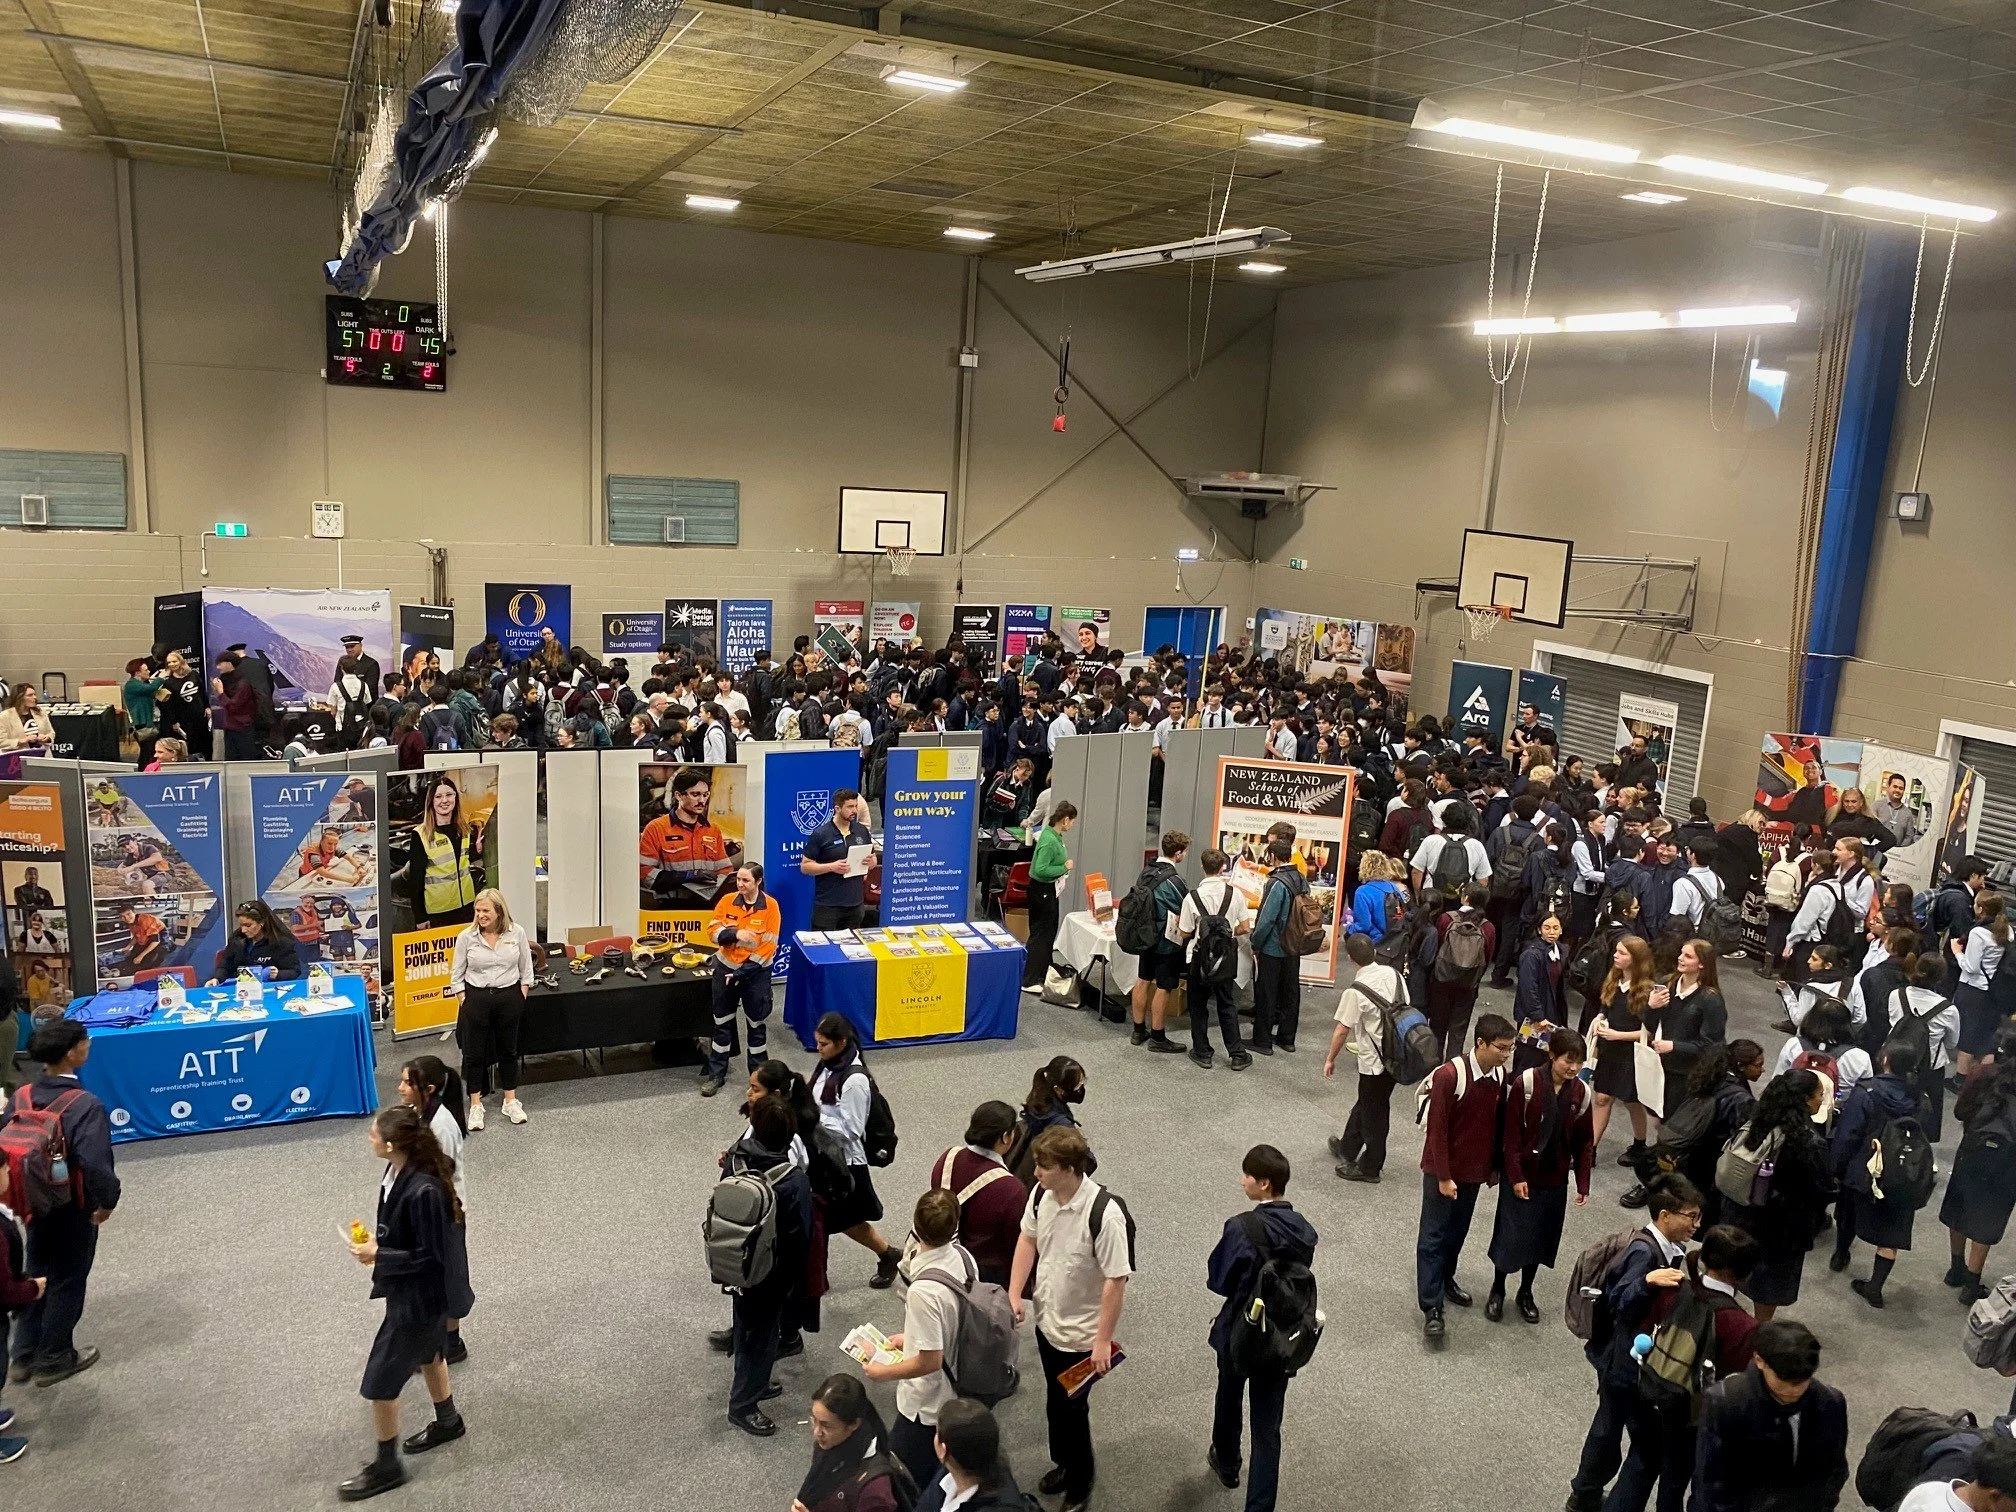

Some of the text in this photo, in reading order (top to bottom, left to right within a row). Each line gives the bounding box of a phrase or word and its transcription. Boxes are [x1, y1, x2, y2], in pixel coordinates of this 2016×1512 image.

[343, 330, 364, 347] 57
[420, 338, 440, 354] 45
[383, 363, 390, 374] 2
[424, 366, 432, 377] 2
[626, 619, 657, 627] University
[505, 629, 542, 637] Universi
[727, 627, 765, 638] Aloha
[727, 645, 765, 657] Mau
[1461, 710, 1489, 725] Ara
[1230, 769, 1320, 786] NEW ZEALAND
[162, 786, 199, 801] ATT
[1249, 781, 1300, 795] School of
[278, 787, 314, 802] ATT
[894, 790, 966, 802] Grow your
[1228, 791, 1259, 805] Food
[1262, 794, 1274, 807] &
[894, 807, 955, 817] own way.
[0, 830, 41, 842] tarting
[0, 842, 58, 854] nticeship?
[647, 921, 701, 932] FIND YOUR
[1747, 928, 1766, 943] Hau
[404, 941, 429, 956] FIND
[405, 951, 448, 969] POWER.
[405, 966, 432, 982] JOIN
[412, 992, 434, 1001] TERRA
[901, 995, 942, 1004] LINCOLN
[179, 1047, 244, 1079] ATT
[150, 1082, 200, 1093] Apprenticeship
[224, 1113, 261, 1121] DRAINLAYING
[166, 1120, 199, 1129] GASFITTING
